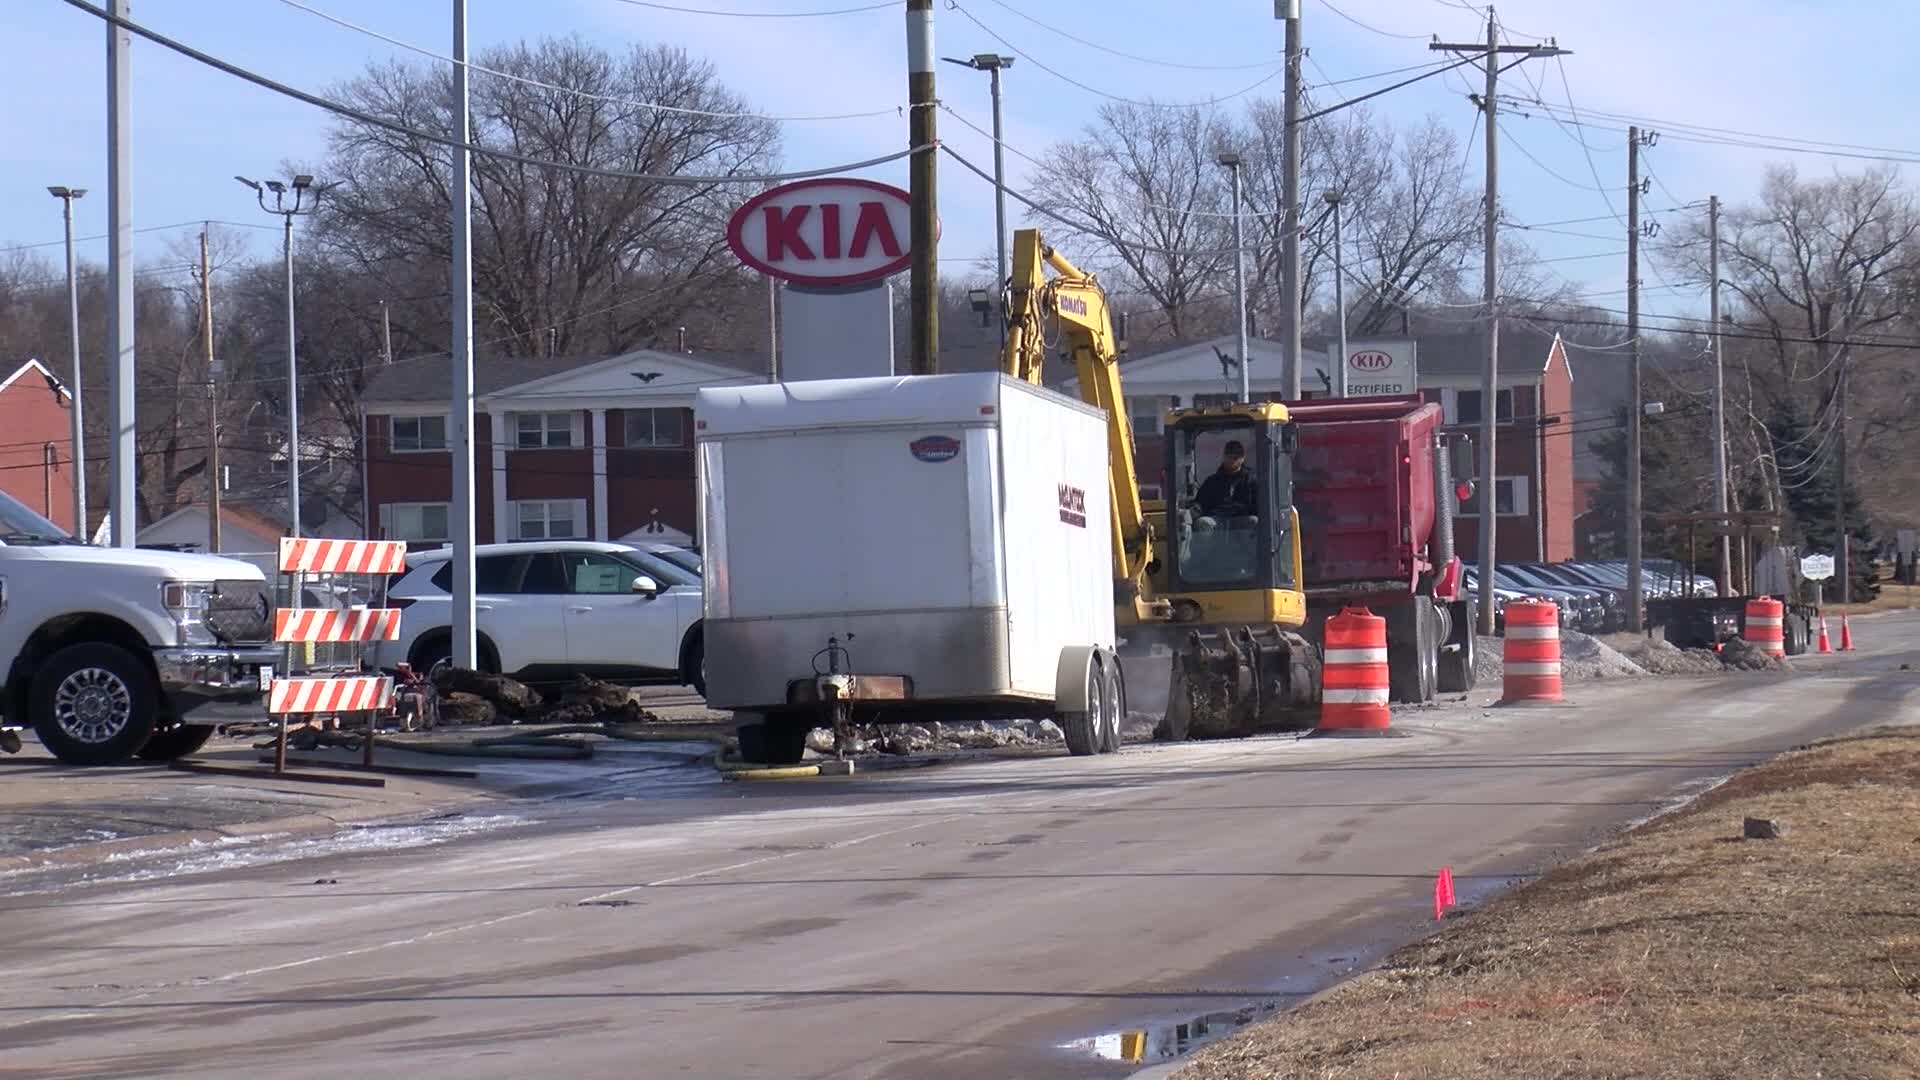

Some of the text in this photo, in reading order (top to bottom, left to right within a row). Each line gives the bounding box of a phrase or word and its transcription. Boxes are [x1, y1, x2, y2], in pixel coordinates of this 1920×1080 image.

[762, 202, 903, 261] KIA
[1357, 354, 1385, 368] KIA
[1347, 384, 1402, 395] ERTIFIED
